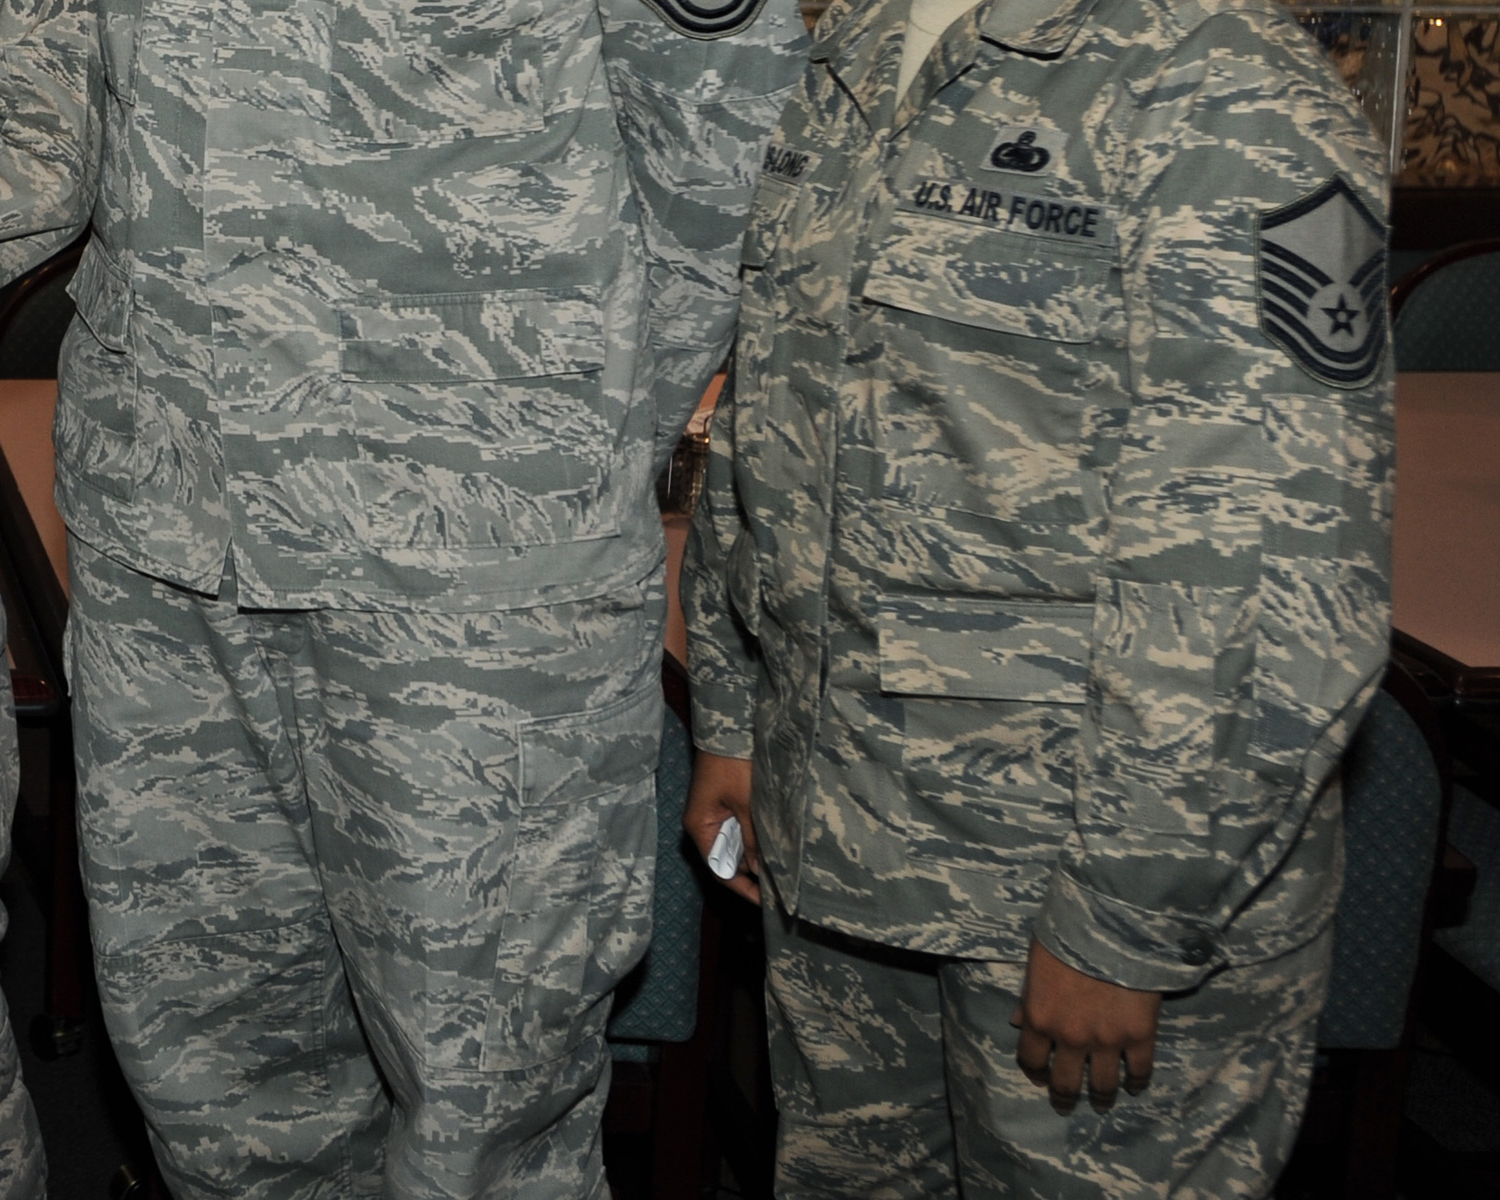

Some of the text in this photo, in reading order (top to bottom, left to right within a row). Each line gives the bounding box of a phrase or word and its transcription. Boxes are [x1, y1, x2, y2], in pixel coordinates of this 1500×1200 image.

[915, 181, 1100, 238] U.S. AIR FORCE
